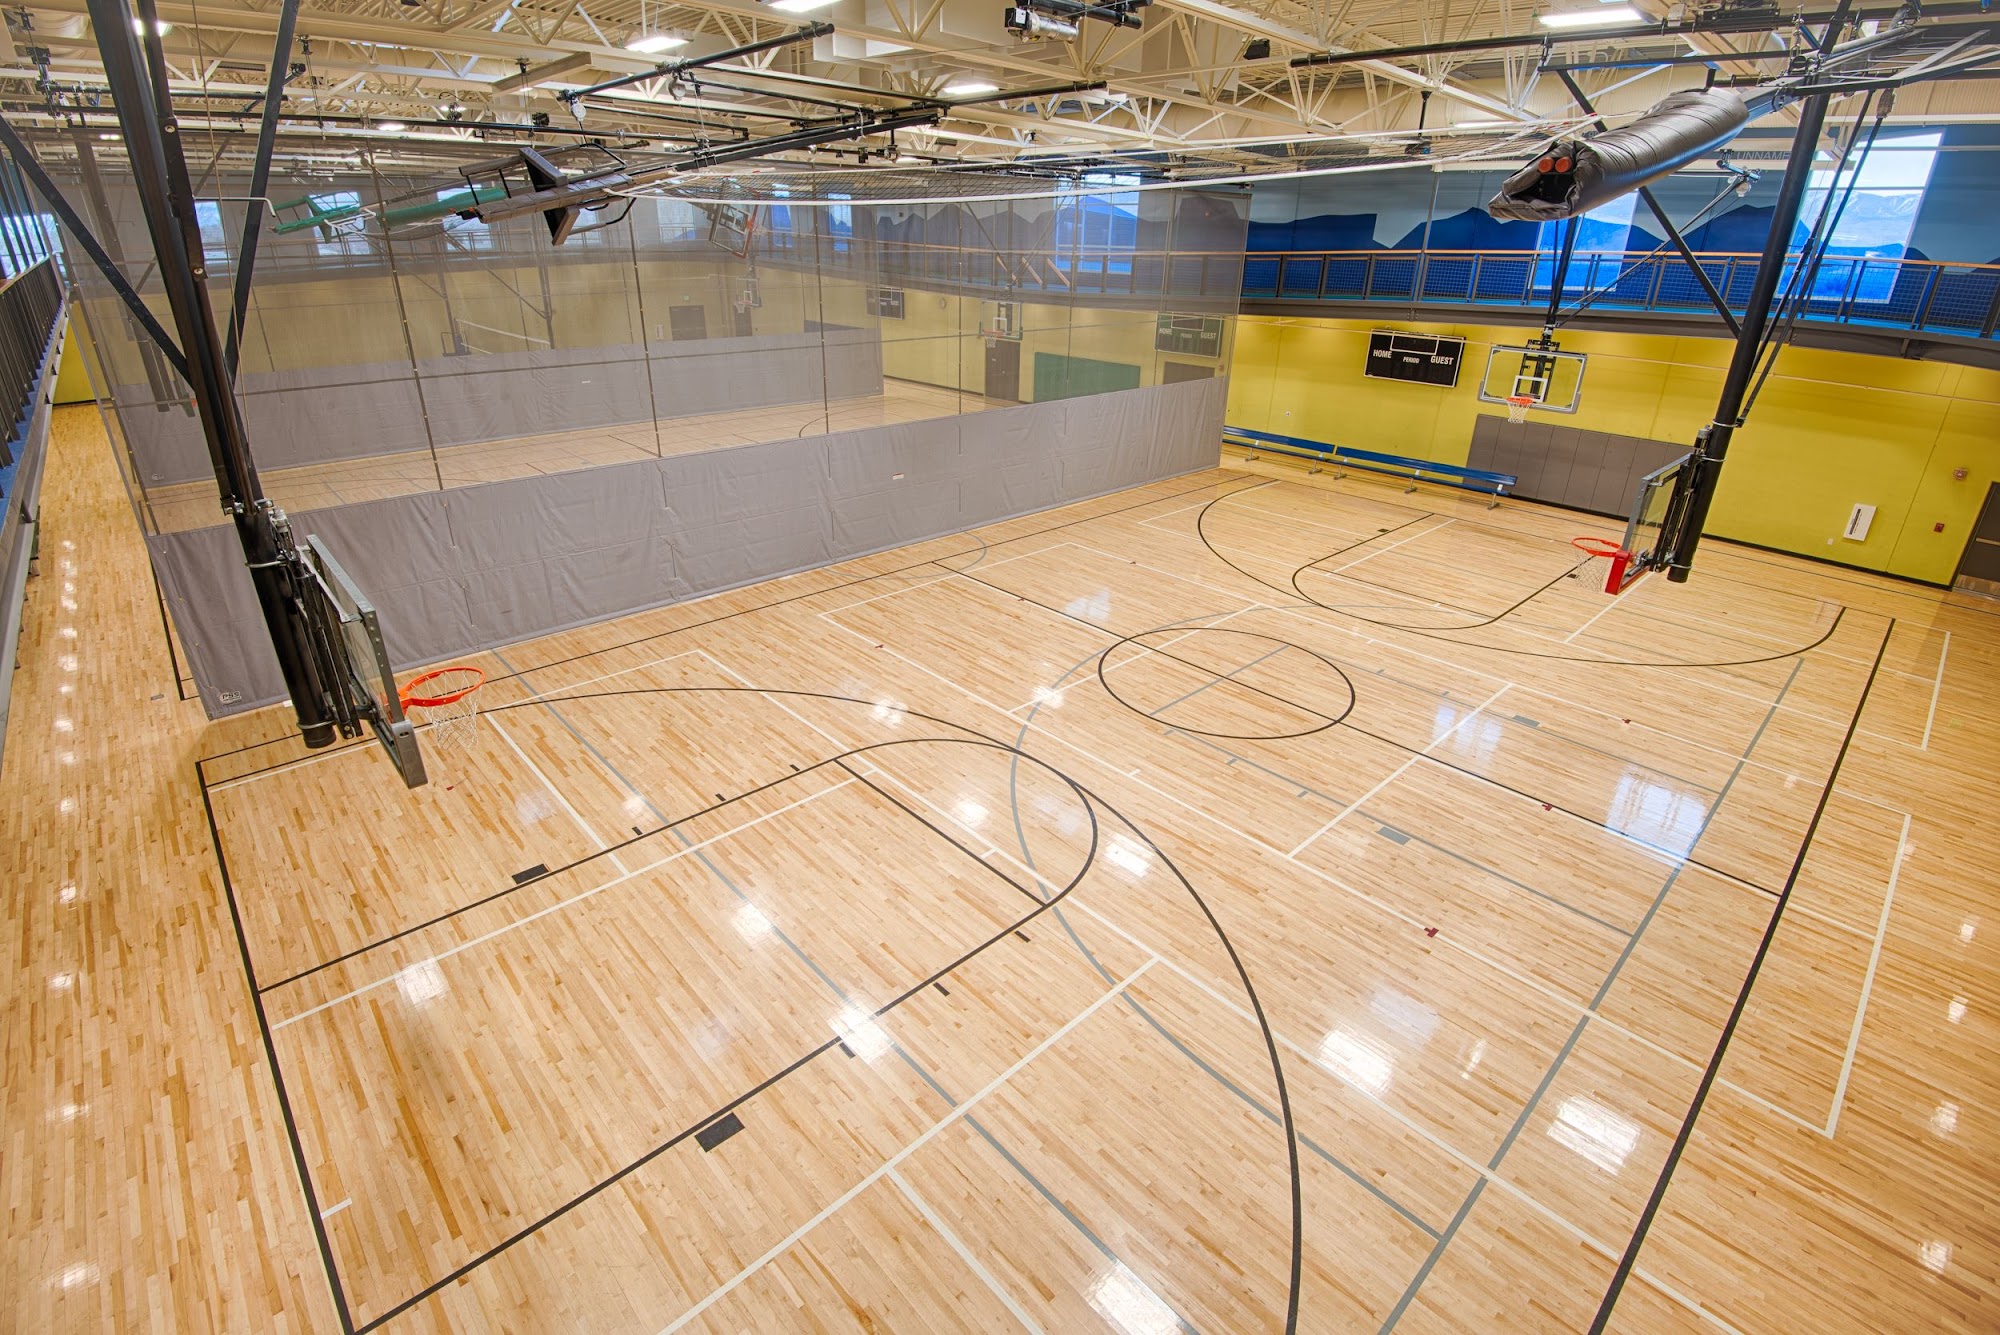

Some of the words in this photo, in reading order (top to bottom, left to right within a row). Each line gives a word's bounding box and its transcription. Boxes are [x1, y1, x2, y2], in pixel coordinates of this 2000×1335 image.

[1373, 349, 1392, 358] HOME
[1403, 356, 1419, 364] PERIOD
[1430, 356, 1454, 365] GUEST
